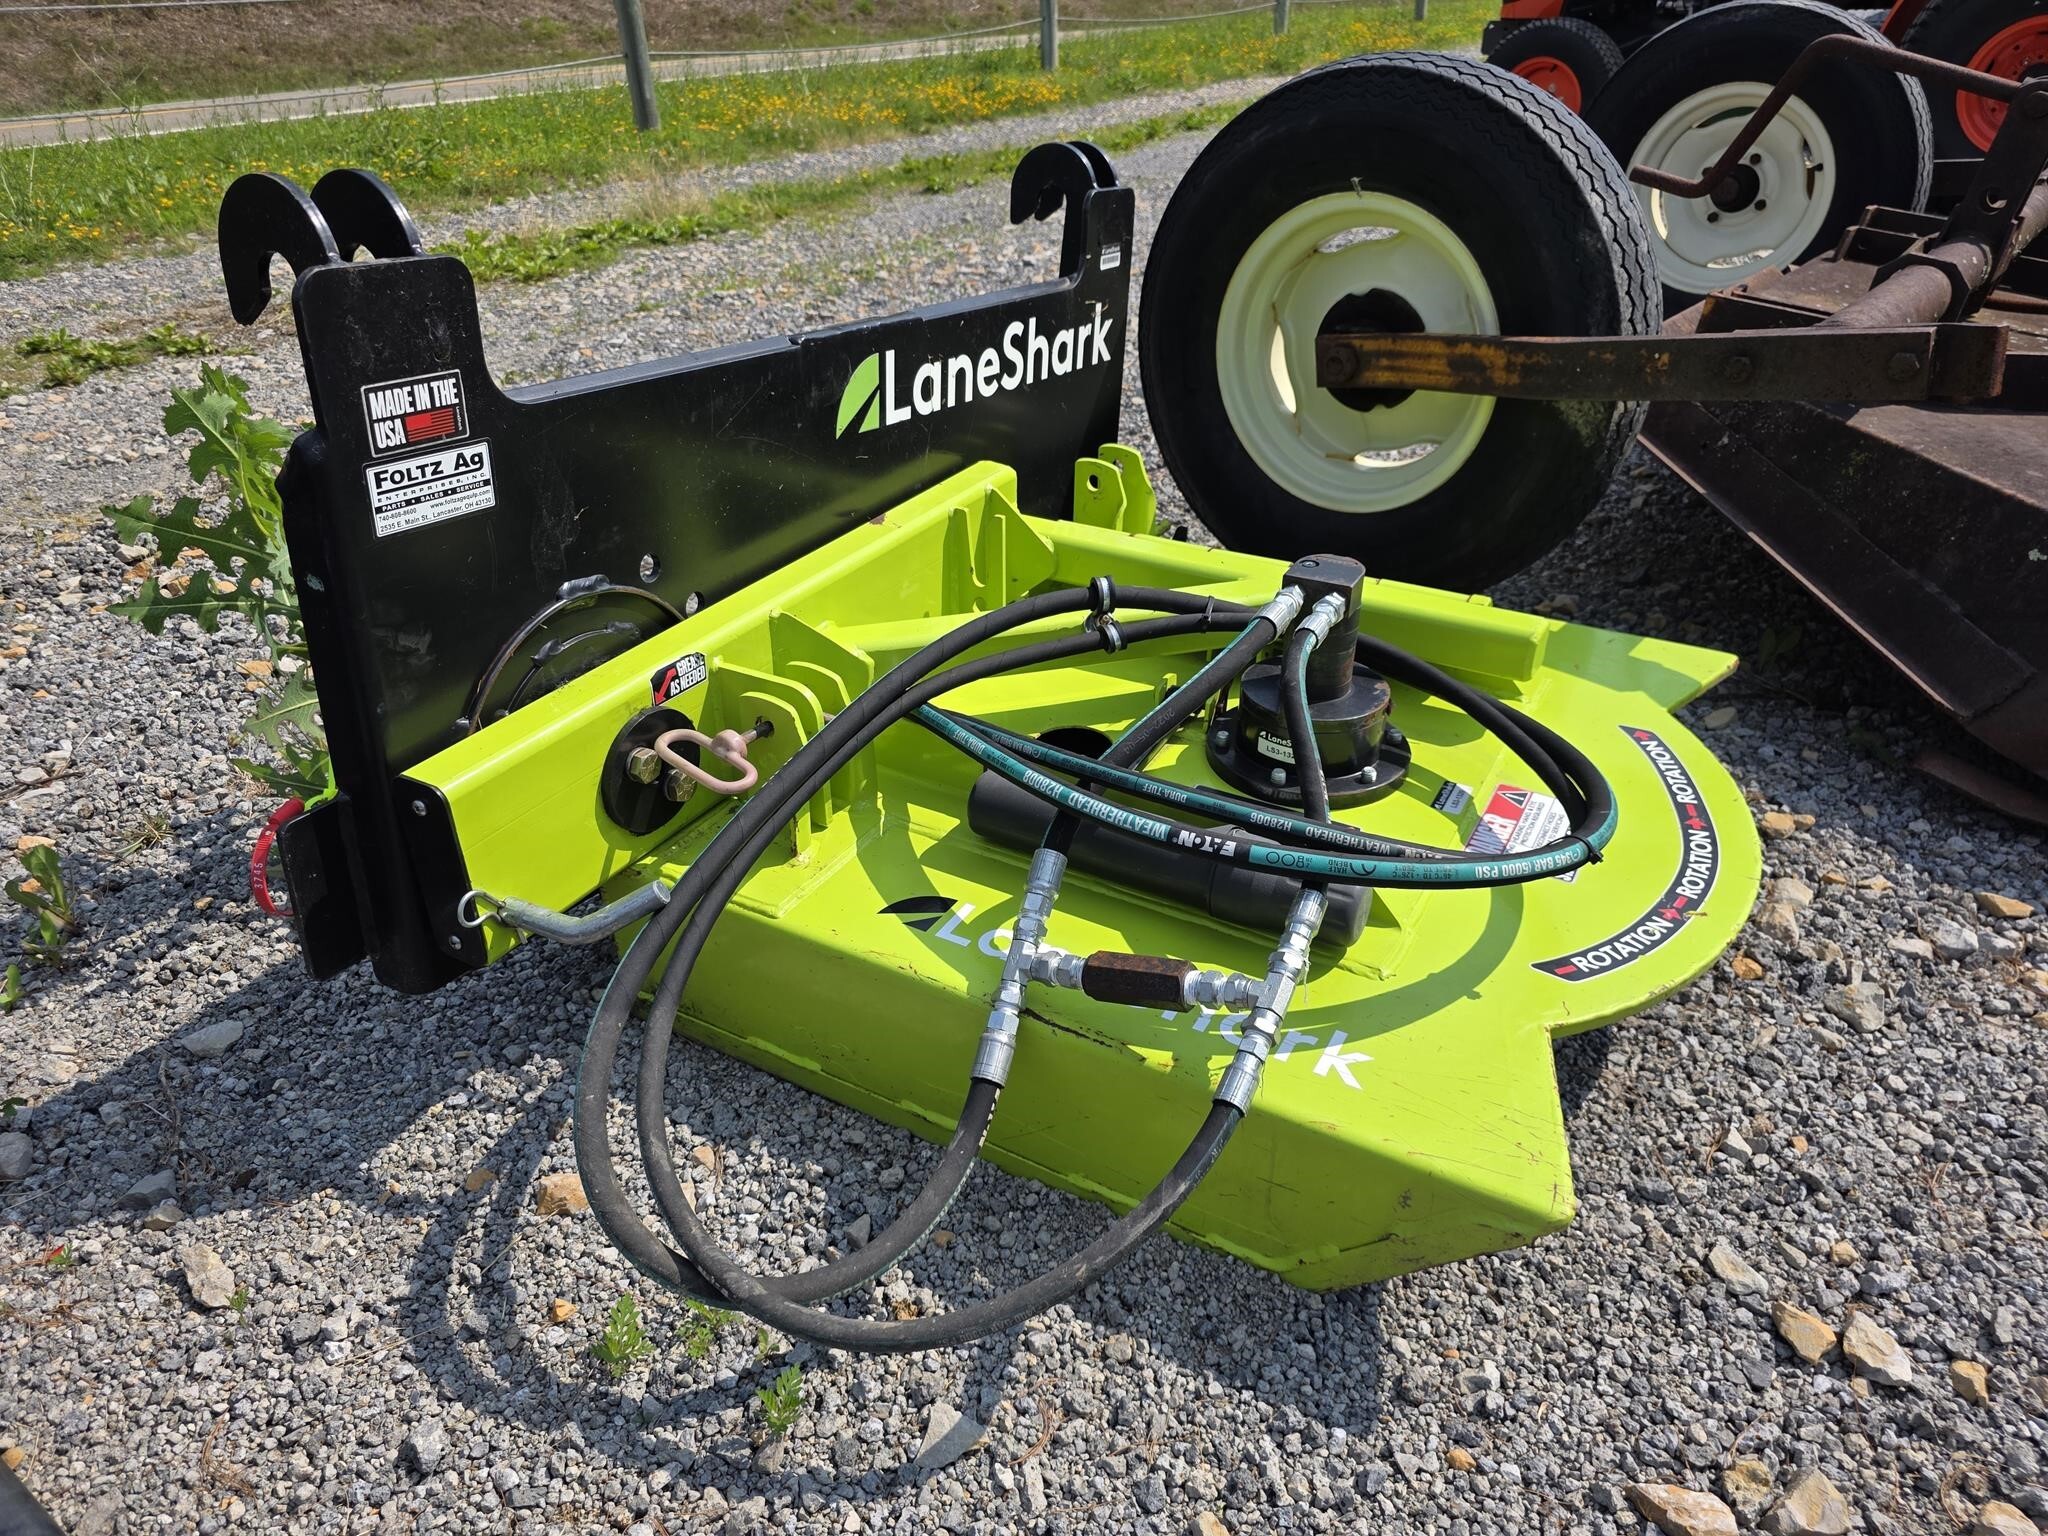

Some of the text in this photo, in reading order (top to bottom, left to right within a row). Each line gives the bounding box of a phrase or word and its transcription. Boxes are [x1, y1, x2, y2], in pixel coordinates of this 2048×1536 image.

[885, 303, 1113, 426] LaneShark
[369, 378, 459, 420] MADE IN THE
[373, 418, 407, 449] USA
[373, 451, 484, 489] FOLTZ Ag
[382, 481, 485, 512] PARTS SALES SERVICE
[380, 522, 396, 533] 2535
[405, 516, 420, 526] Main
[464, 501, 474, 510] OH
[475, 496, 492, 506] 43130
[675, 653, 705, 677] GREASE
[670, 665, 706, 697] AS NEEDED
[1267, 733, 1293, 748] LaneS
[1023, 770, 1064, 799] H28008
[1639, 740, 1698, 805] ROTATION
[1069, 792, 1172, 842] WEATHERHEAD
[1250, 812, 1293, 832] H28006
[1464, 811, 1517, 854] DANGER
[1305, 826, 1391, 856] WEATHERHEAD
[254, 861, 263, 889] 3745
[1501, 863, 1532, 877] (5000
[1534, 856, 1554, 872] BAR
[1676, 829, 1712, 899] ROTATION
[1570, 916, 1674, 973] ROTATION
